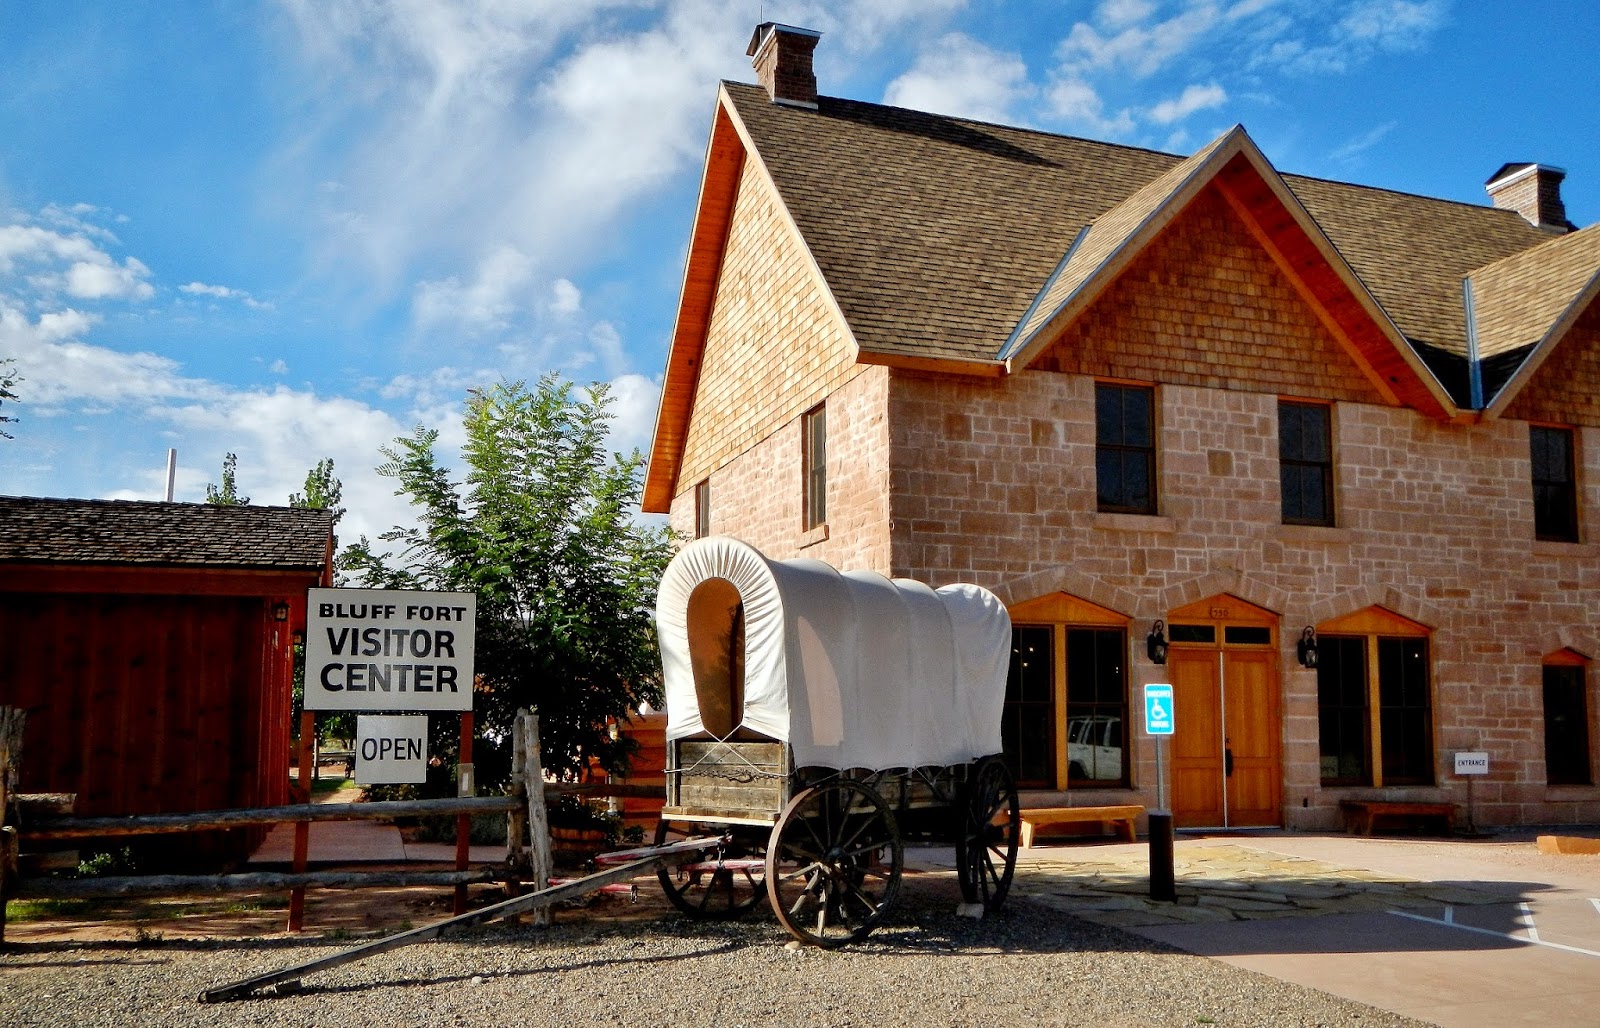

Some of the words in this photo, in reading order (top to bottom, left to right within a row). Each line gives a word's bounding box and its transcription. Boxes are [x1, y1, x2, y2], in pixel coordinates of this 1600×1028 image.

[319, 603, 396, 619] BLUFF
[406, 605, 467, 622] FORT
[326, 627, 455, 659] VISITOR
[320, 662, 458, 693] CENTER
[361, 737, 422, 762] OPEN
